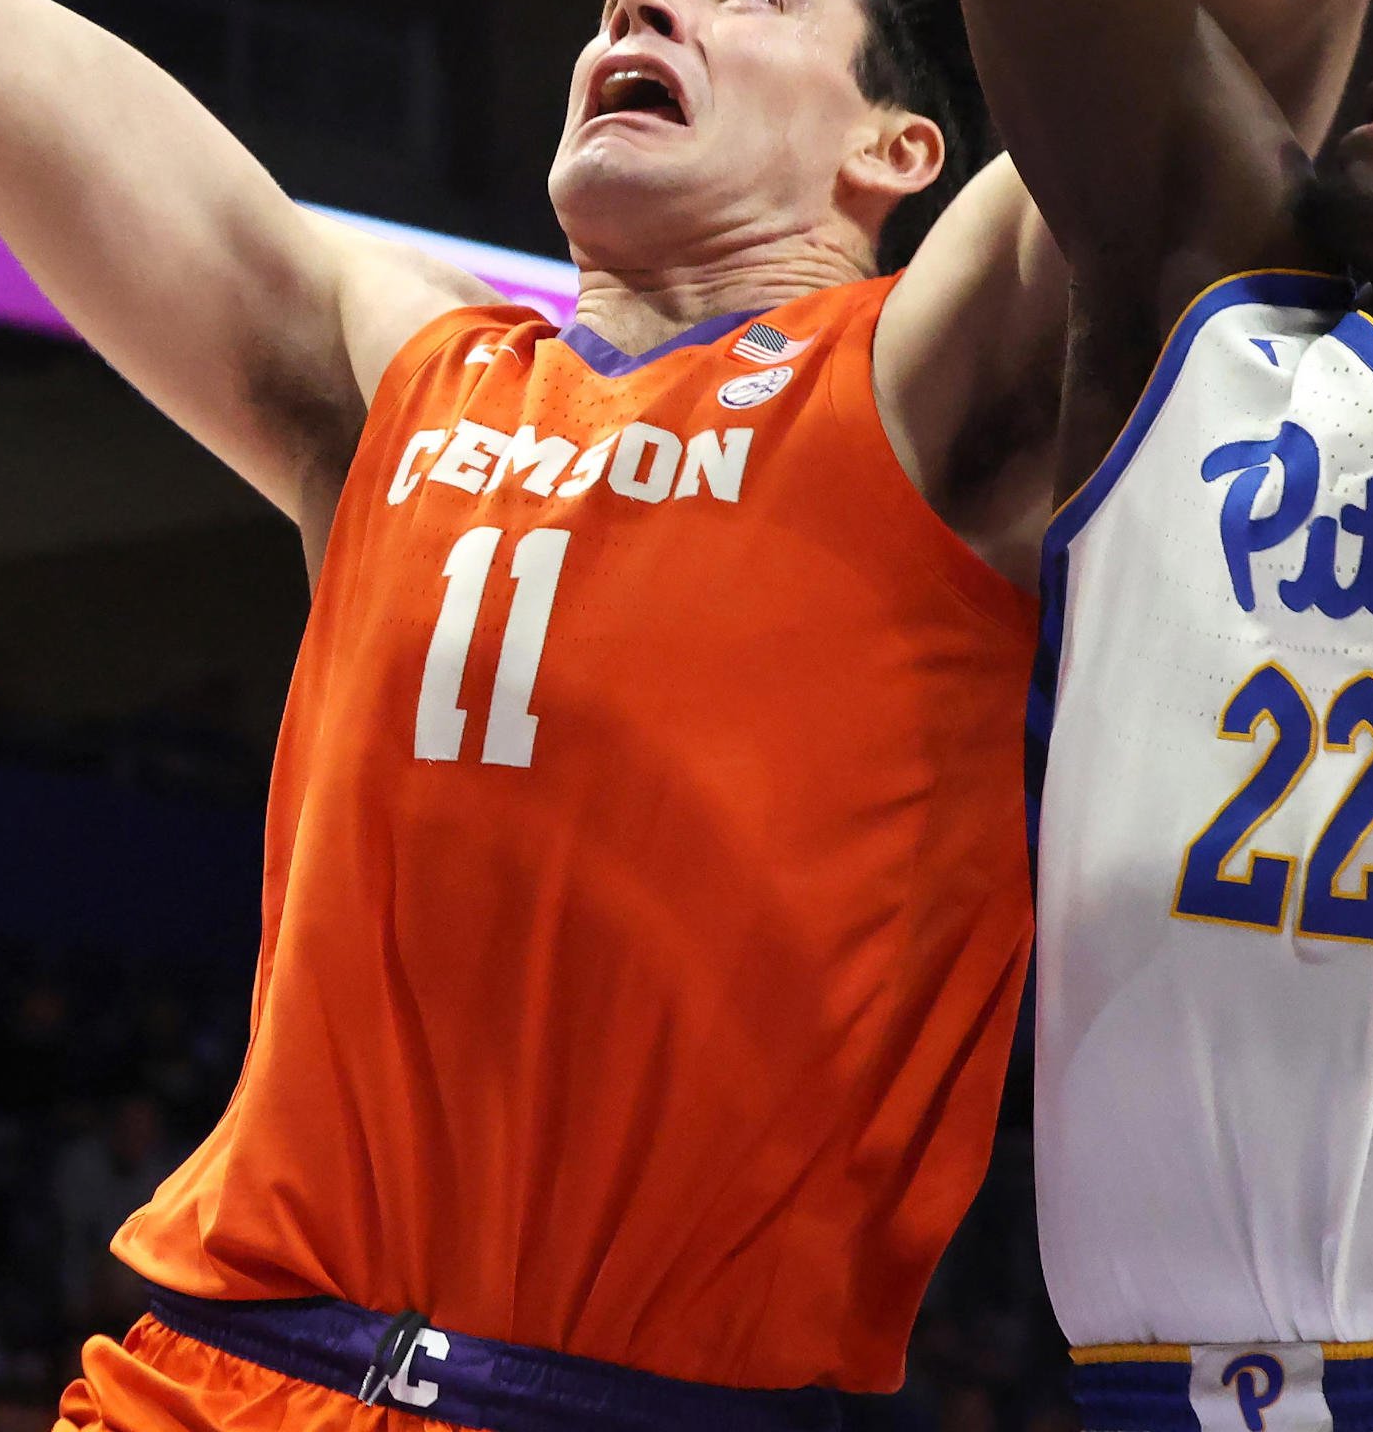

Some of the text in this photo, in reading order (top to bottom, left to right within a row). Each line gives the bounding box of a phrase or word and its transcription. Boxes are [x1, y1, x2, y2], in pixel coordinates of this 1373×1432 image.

[387, 418, 754, 505] CEMSON
[414, 526, 571, 768] 11
[1221, 1352, 1284, 1432] P
